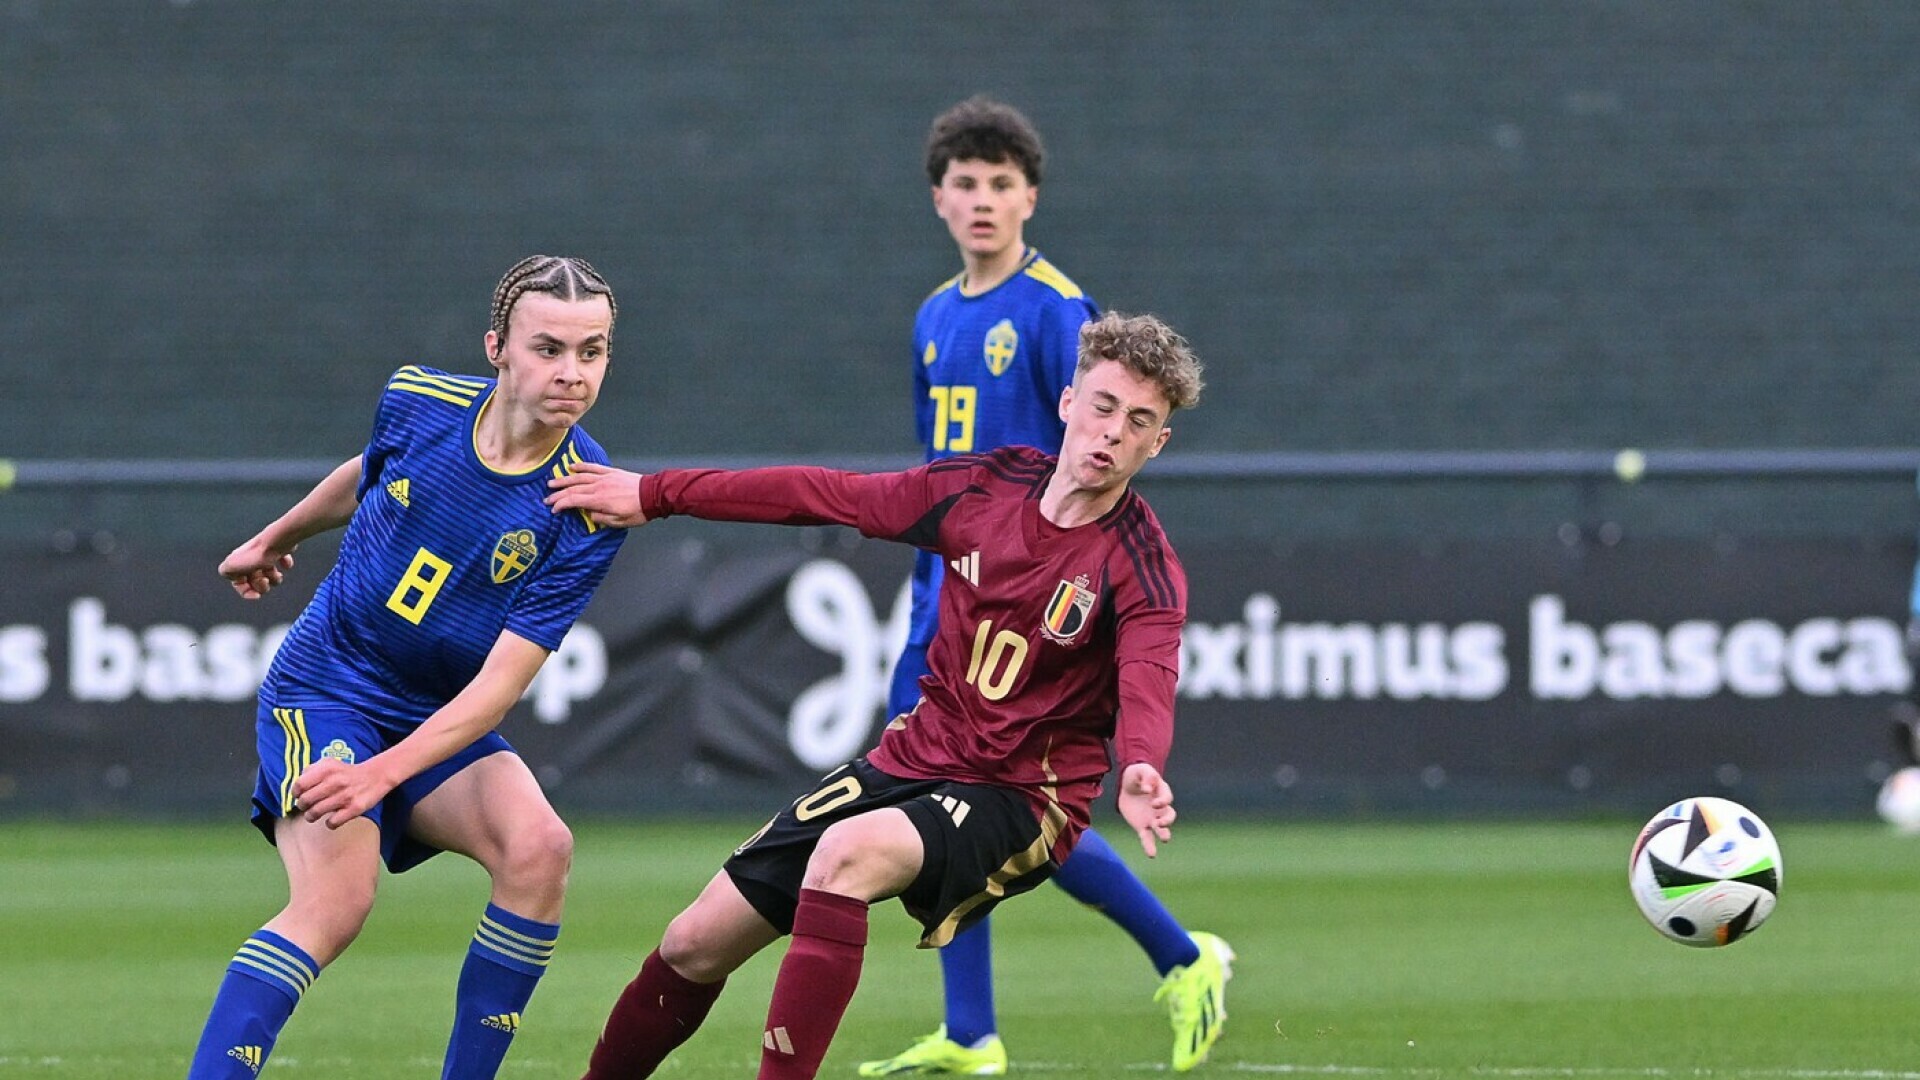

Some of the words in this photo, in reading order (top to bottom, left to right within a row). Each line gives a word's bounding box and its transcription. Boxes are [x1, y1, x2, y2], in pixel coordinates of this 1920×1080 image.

[929, 385, 977, 452] 19
[385, 546, 454, 626] 8
[965, 619, 1028, 701] 10
[1176, 593, 1509, 700] ximus
